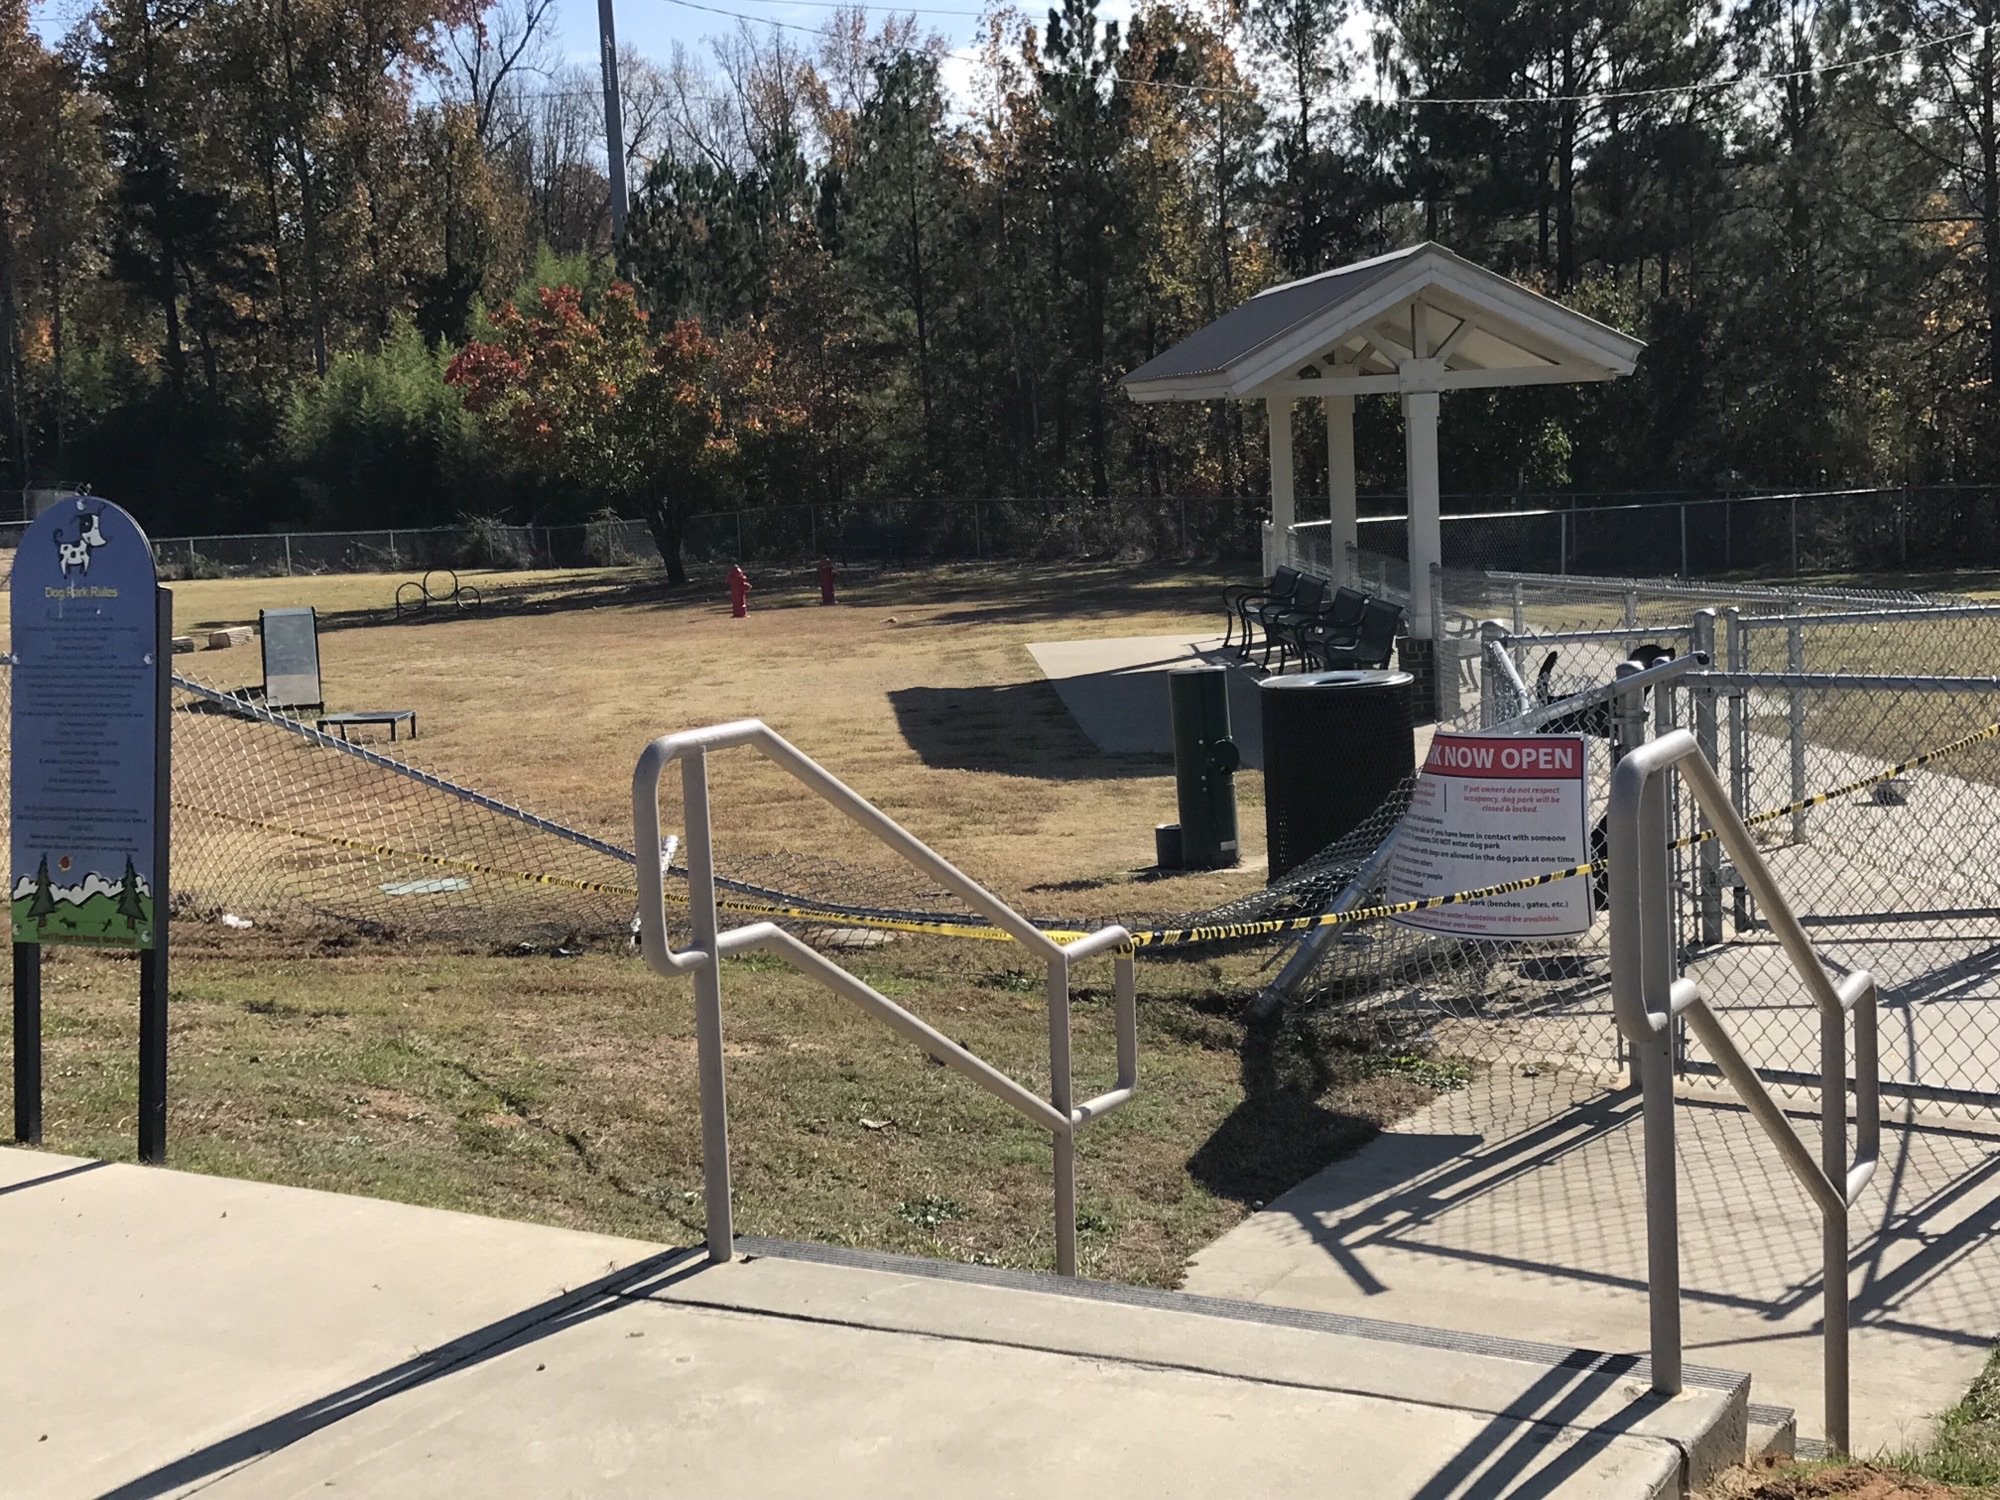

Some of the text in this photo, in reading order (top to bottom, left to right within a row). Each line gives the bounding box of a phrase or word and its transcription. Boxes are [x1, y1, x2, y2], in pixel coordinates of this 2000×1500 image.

[45, 586, 119, 601] Dog Park Rules
[1445, 746, 1495, 769] NOW
[1501, 747, 1573, 770] OPEN
[1469, 786, 1480, 794] pet
[1480, 786, 1506, 794] owners
[1518, 786, 1531, 794] not
[1532, 787, 1560, 795] respect
[1501, 796, 1516, 804] dog
[1516, 796, 1535, 805] park
[1482, 804, 1505, 813] closed
[1512, 805, 1539, 813] locked.
[1459, 831, 1475, 839] been
[1484, 833, 1511, 841] contact
[1440, 838, 1451, 846] NOT
[1469, 841, 1483, 850] dog
[1483, 842, 1500, 851] park
[1450, 851, 1474, 860] allowed
[1496, 854, 1511, 863] dog
[1512, 855, 1530, 863] park
[1469, 900, 1486, 908] park
[1487, 900, 1521, 908] (benches
[1526, 901, 1550, 910] gates,
[1551, 901, 1569, 909] etc.)
[1464, 913, 1497, 921] fountains
[1440, 919, 1452, 927] your
